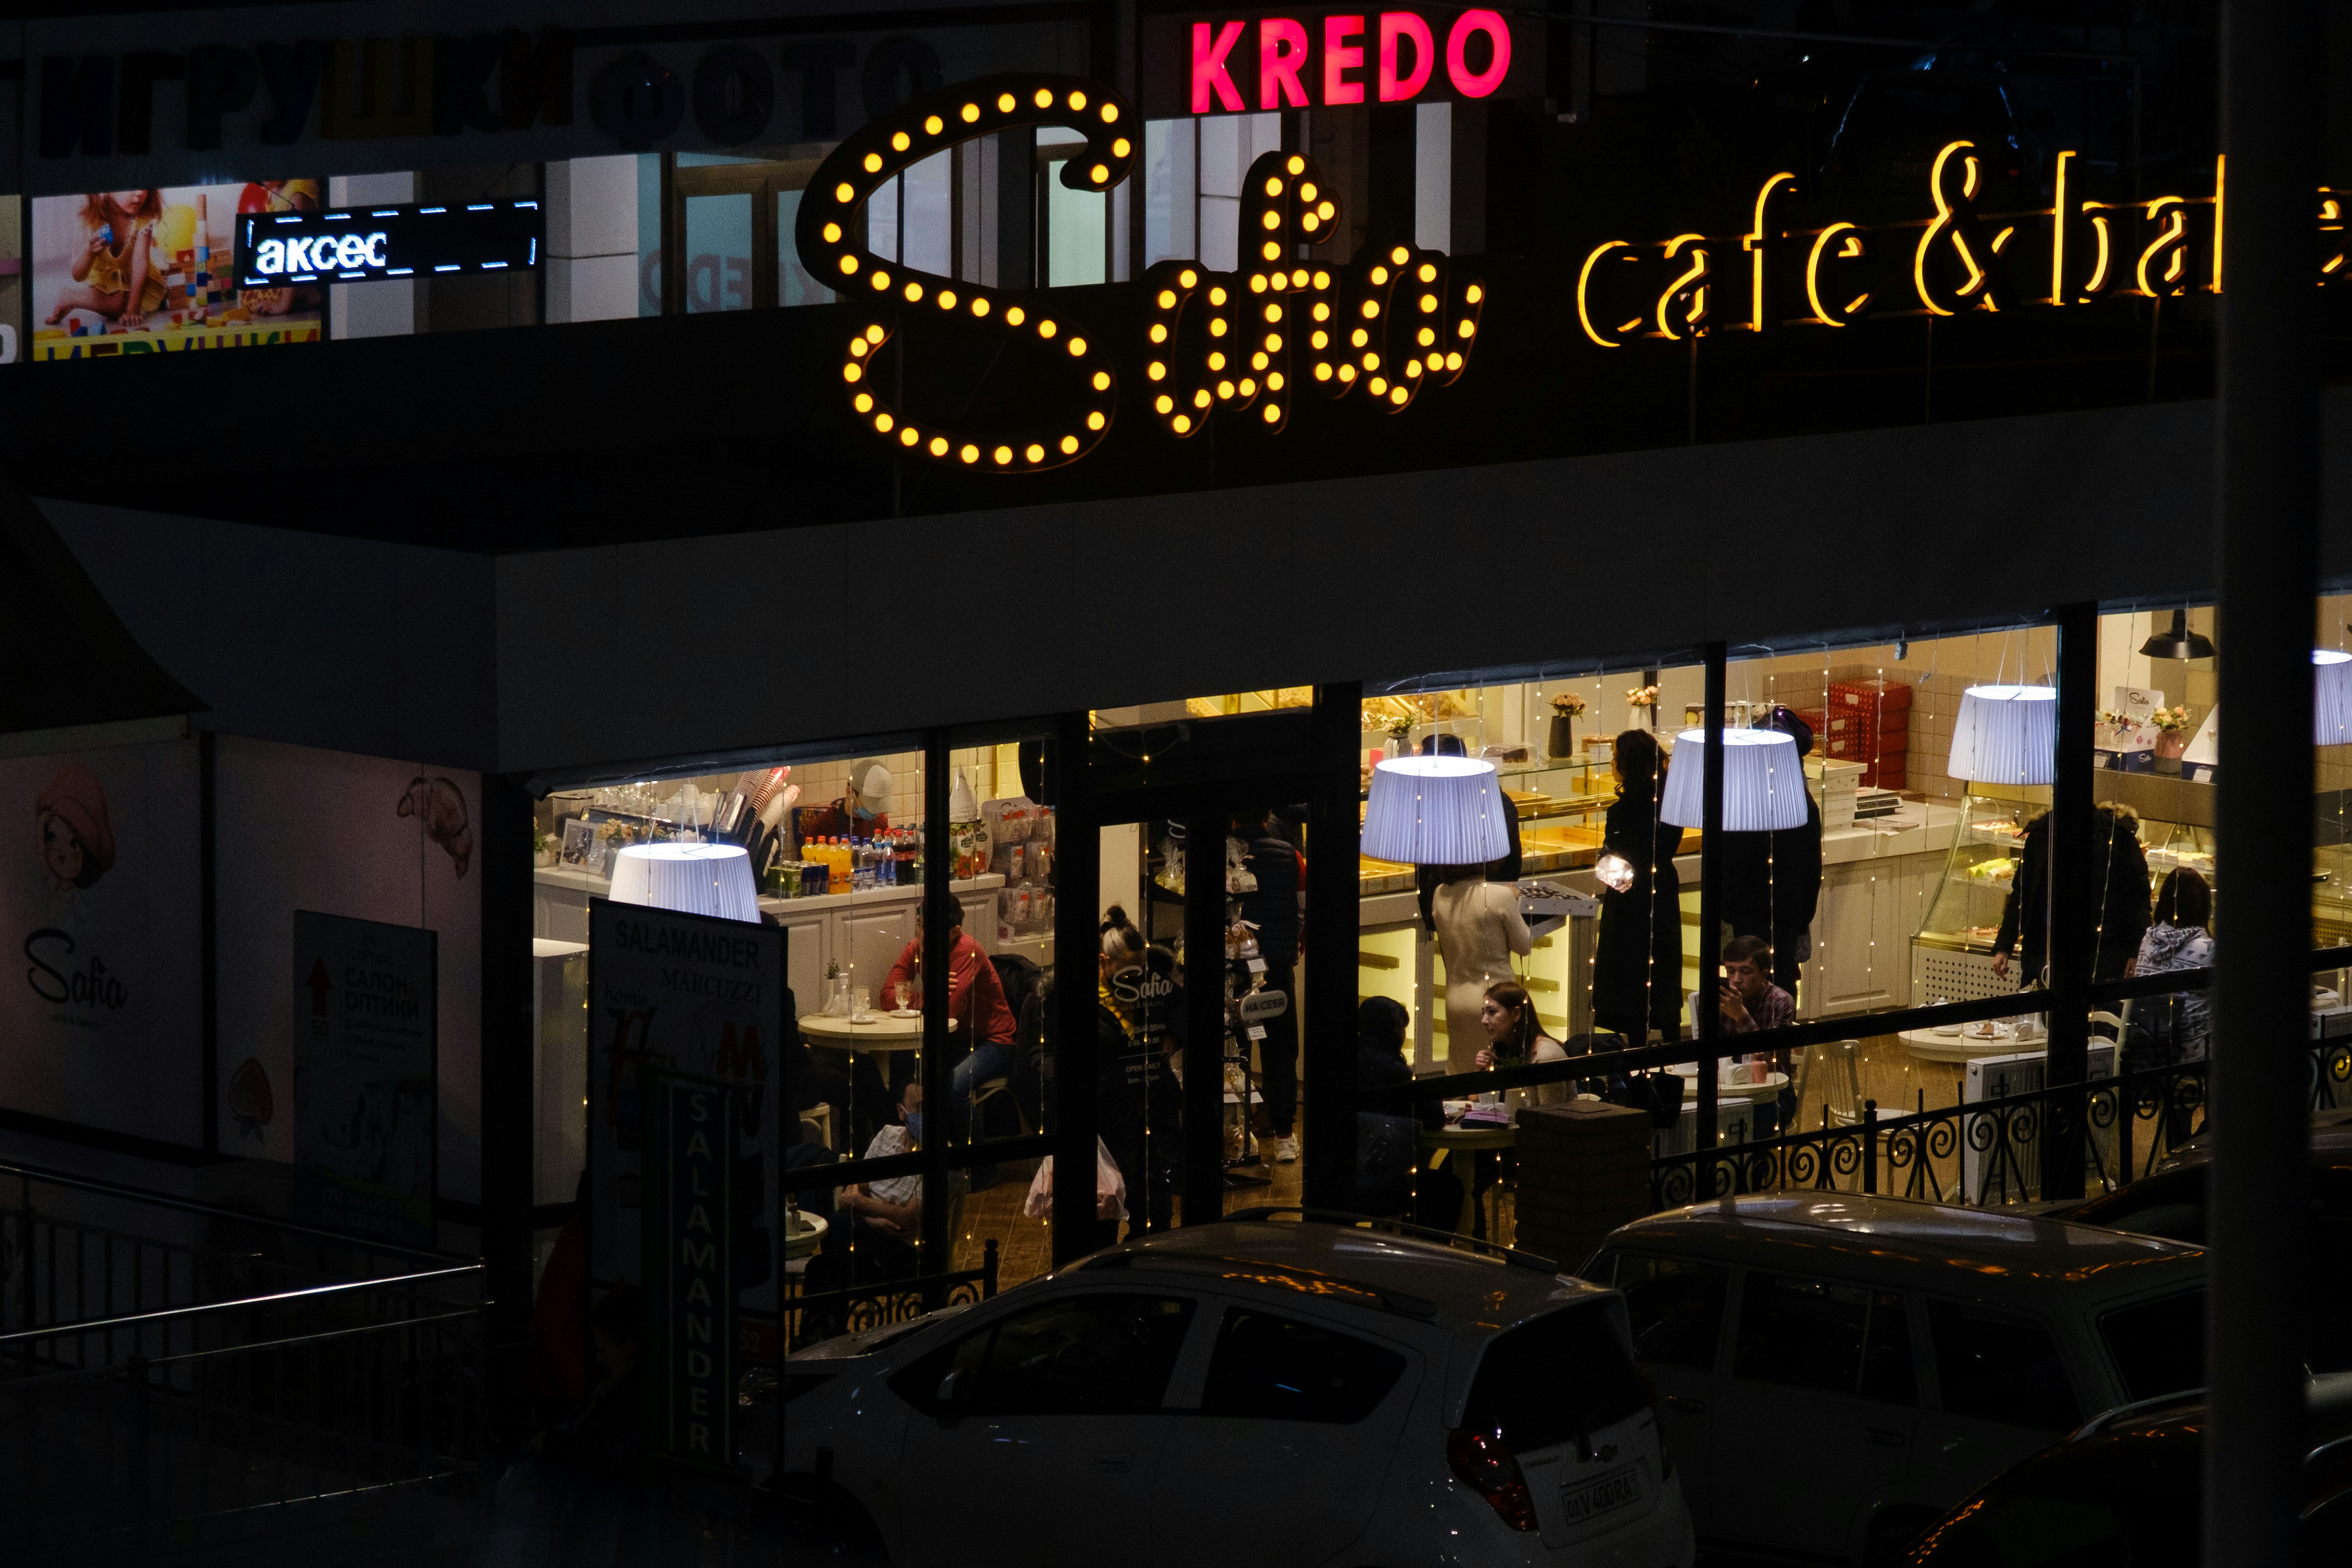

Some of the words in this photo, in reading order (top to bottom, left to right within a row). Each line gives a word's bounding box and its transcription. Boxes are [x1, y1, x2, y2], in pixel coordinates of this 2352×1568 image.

[1191, 8, 1512, 114] KREDO
[38, 26, 574, 157] ИГРУШКИ
[588, 36, 944, 151] ФОТО
[256, 232, 387, 274] аксес
[1576, 171, 1869, 348] cafe
[1913, 140, 2020, 317] &
[795, 71, 1486, 474] Safia
[24, 928, 128, 1010] Safia
[615, 919, 759, 970] SALAMANDER
[345, 968, 408, 995] САЛОН
[345, 991, 418, 1020] ОПТИКИ
[661, 969, 762, 1004] MARCUZZI
[1113, 965, 1175, 1002] Safia
[1245, 1002, 1258, 1012] НА
[1261, 998, 1285, 1010] СЕБЯ
[1126, 1064, 1143, 1073] OPEN
[1144, 1062, 1161, 1070] DAILY
[681, 1093, 717, 1454] SALAMANDER
